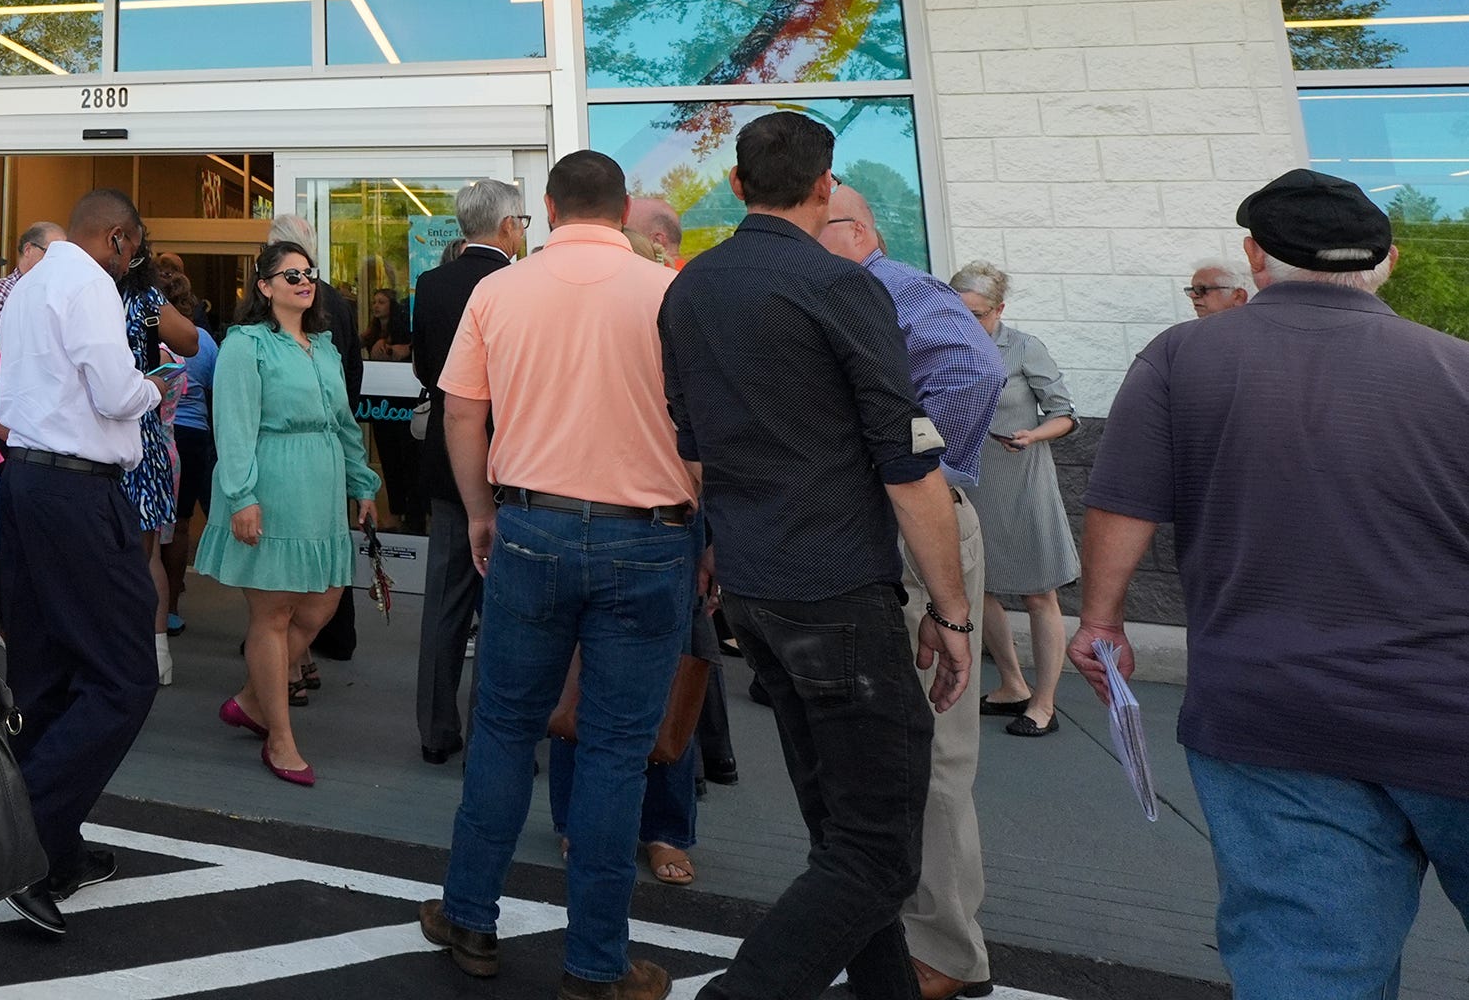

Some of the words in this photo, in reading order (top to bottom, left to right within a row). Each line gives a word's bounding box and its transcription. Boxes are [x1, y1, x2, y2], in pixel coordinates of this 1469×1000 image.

[81, 87, 128, 108] 2880
[427, 228, 452, 237] Enter
[429, 238, 449, 247] cha
[355, 398, 413, 420] Welco
